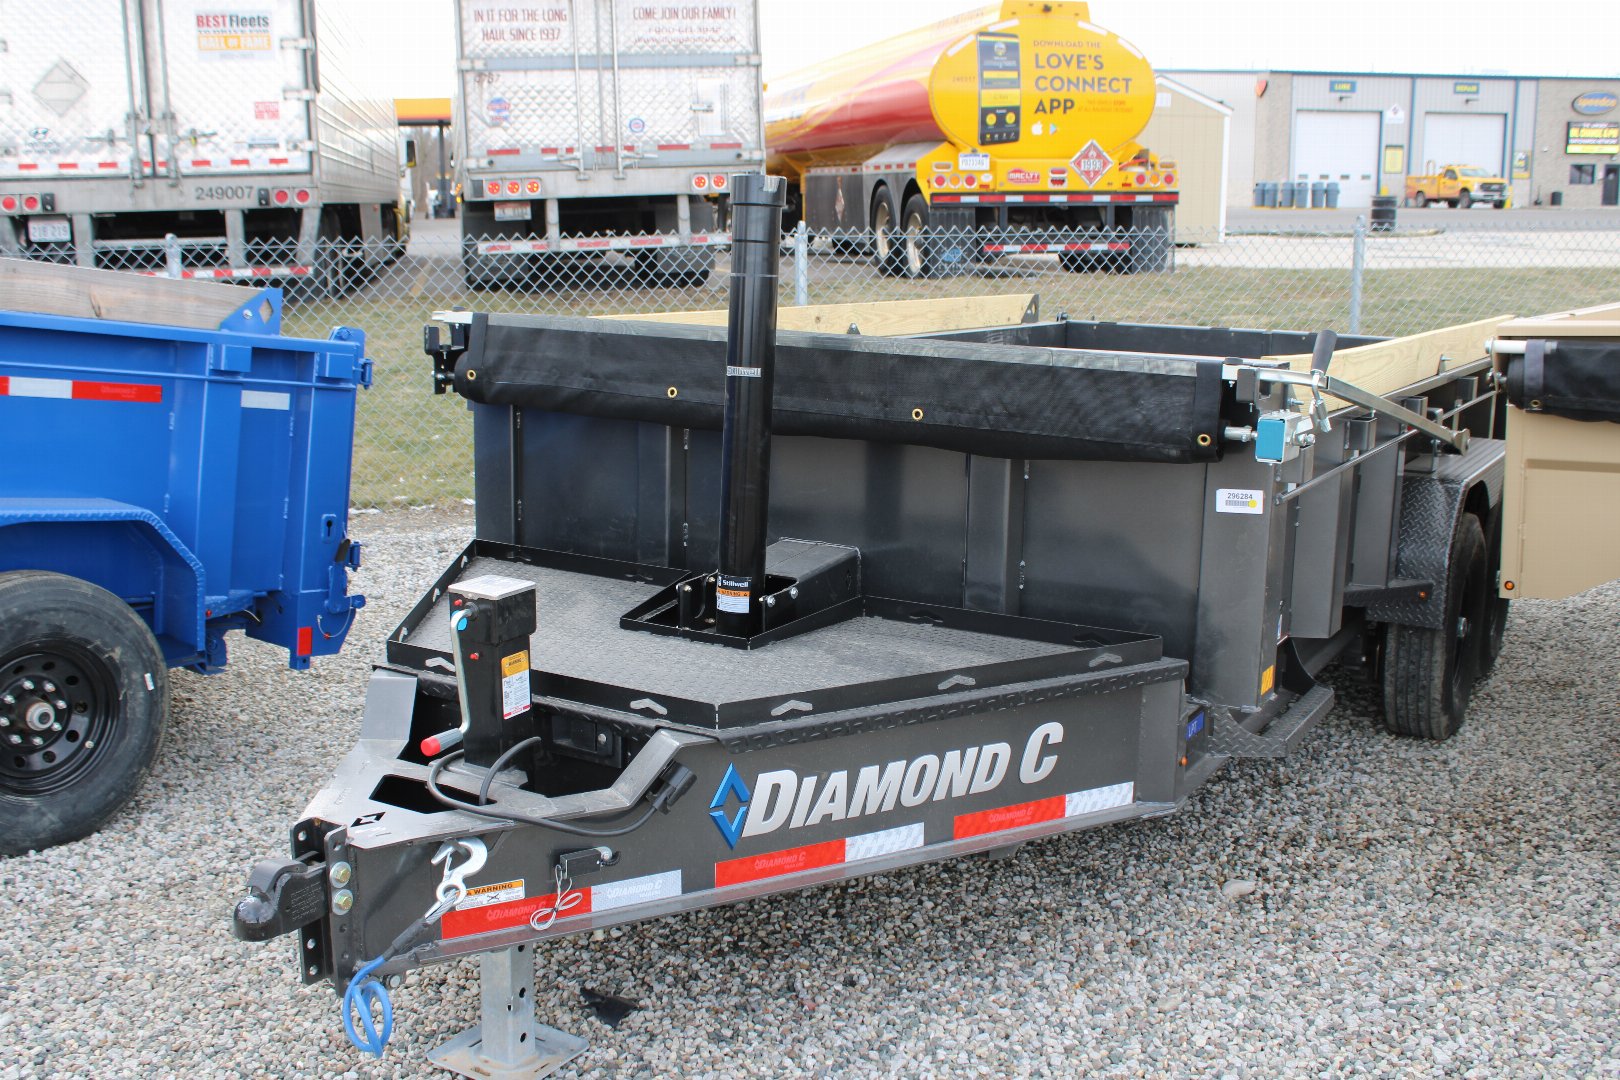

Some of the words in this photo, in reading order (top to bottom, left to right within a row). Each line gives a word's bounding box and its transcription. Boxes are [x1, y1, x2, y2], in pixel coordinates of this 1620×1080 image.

[474, 8, 484, 22] IN
[486, 8, 494, 22] IT
[498, 8, 518, 22] FOR
[521, 8, 539, 22] THE
[542, 8, 567, 22] LONG
[633, 7, 656, 20] COME
[661, 7, 679, 20] JOIN
[681, 7, 700, 20] OUR
[196, 15, 227, 28] BEST
[229, 14, 270, 27] Fleets
[482, 28, 505, 41] HAUL
[509, 28, 537, 41] SINCE
[540, 28, 561, 41] 1937
[1033, 40, 1083, 48] DOWNLOAD
[1034, 53, 1104, 70] LOVE'S
[1034, 76, 1133, 94] CONNECT
[1034, 98, 1075, 115] APP
[1083, 159, 1102, 170] 1993
[195, 185, 254, 201] 249007
[1227, 492, 1253, 500] 296284
[722, 579, 749, 588] Stillwell
[741, 742, 1011, 838] DIAMOND
[1019, 721, 1064, 785] C
[760, 855, 797, 869] DIAMOND
[799, 851, 806, 861] C
[473, 883, 514, 895] WARNING
[613, 883, 653, 898] DIAMOND
[655, 880, 662, 889] C
[492, 904, 537, 919] DIAMOND
[539, 901, 546, 910] C
